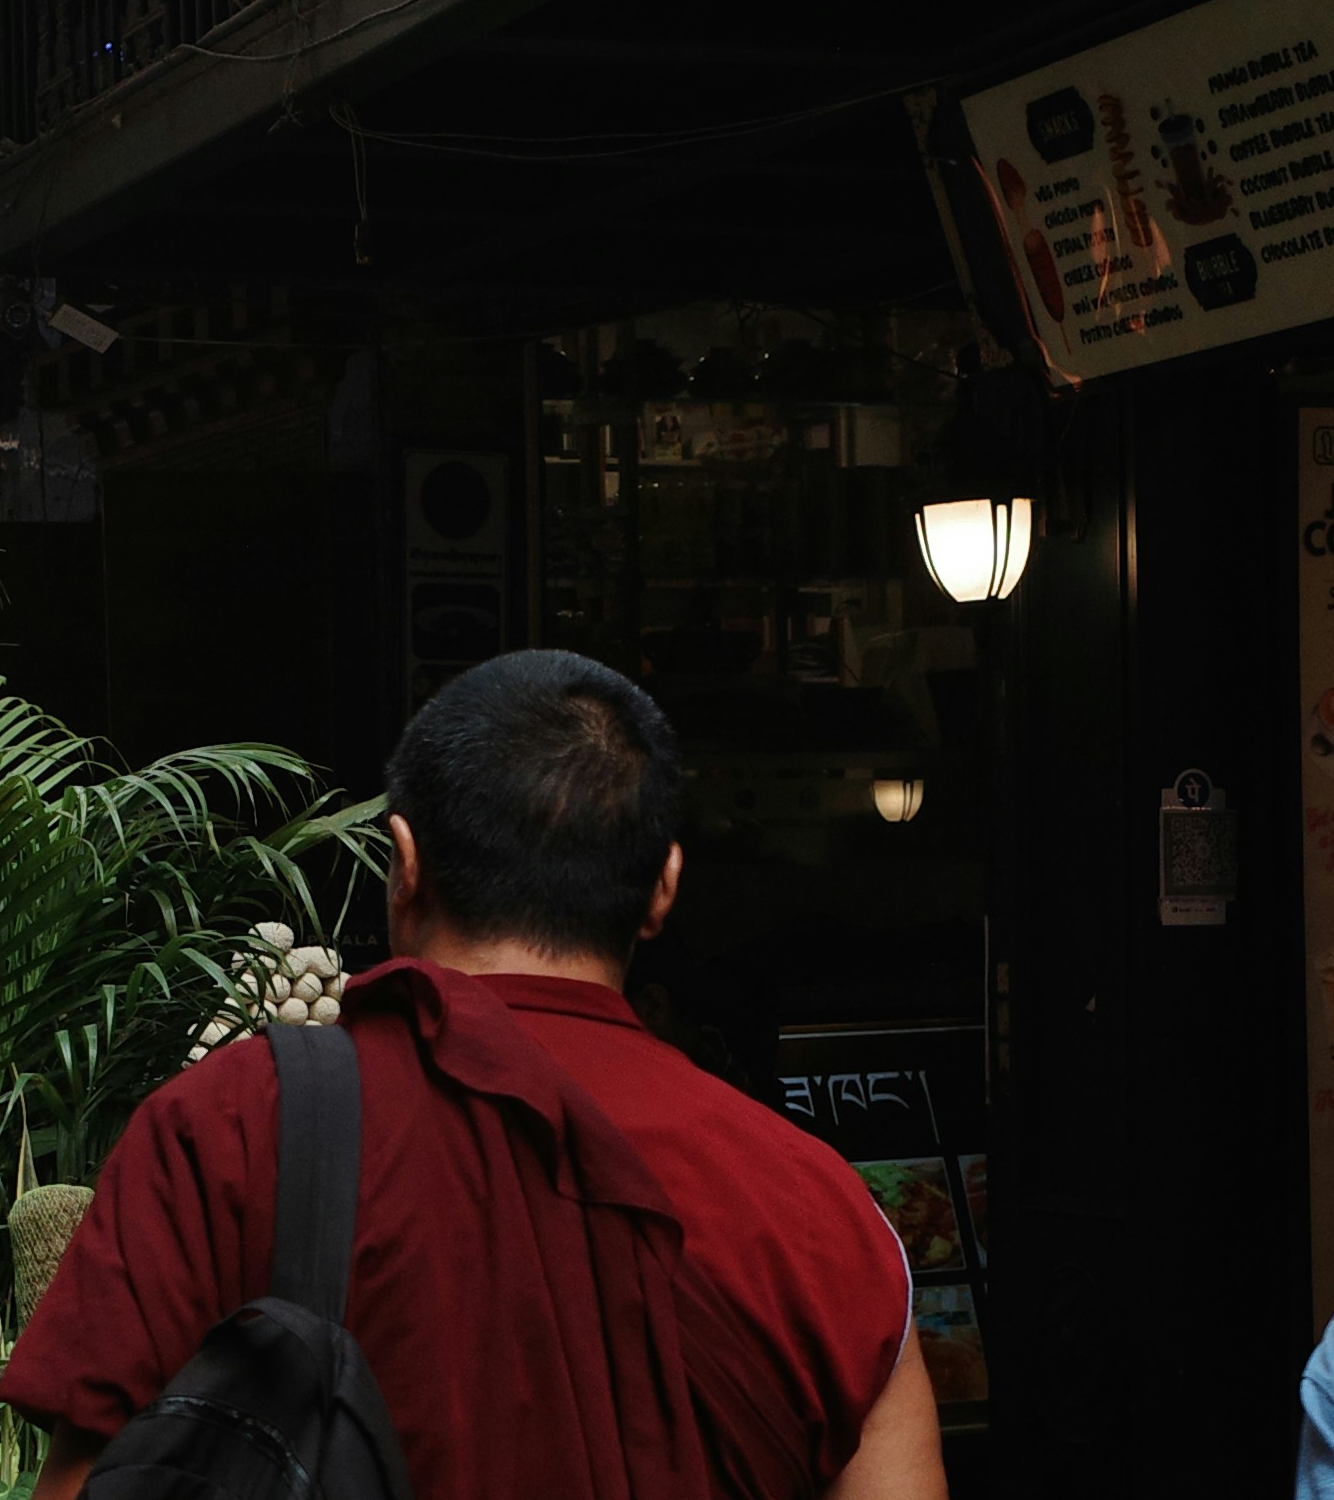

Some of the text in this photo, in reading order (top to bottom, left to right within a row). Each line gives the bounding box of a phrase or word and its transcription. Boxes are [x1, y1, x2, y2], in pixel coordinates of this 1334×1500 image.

[1293, 40, 1319, 63] TEA
[1194, 249, 1244, 283] BUBBLE
[307, 933, 379, 947] POALA
